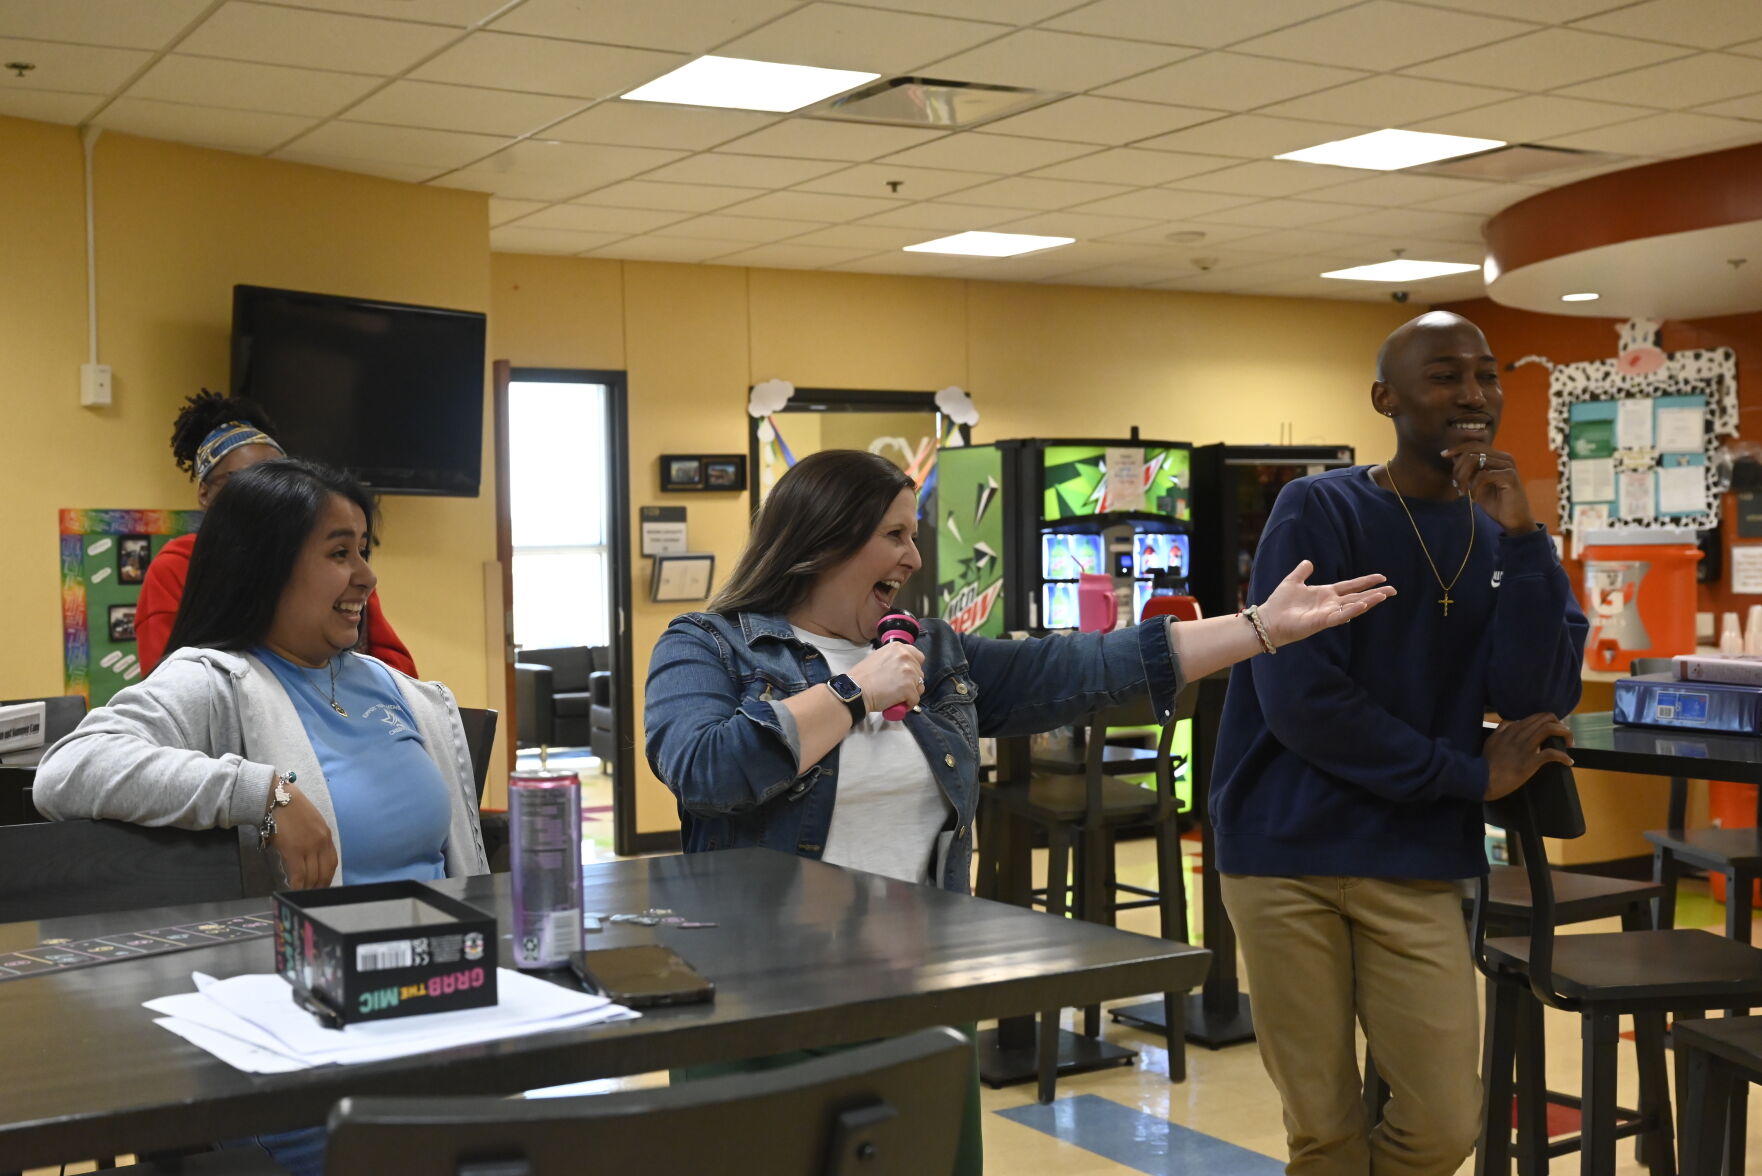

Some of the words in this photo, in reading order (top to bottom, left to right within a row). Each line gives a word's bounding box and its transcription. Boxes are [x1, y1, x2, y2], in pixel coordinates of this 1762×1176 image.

[400, 983, 427, 1001] THE
[428, 967, 485, 997] GRAB
[358, 986, 400, 1014] MIC
